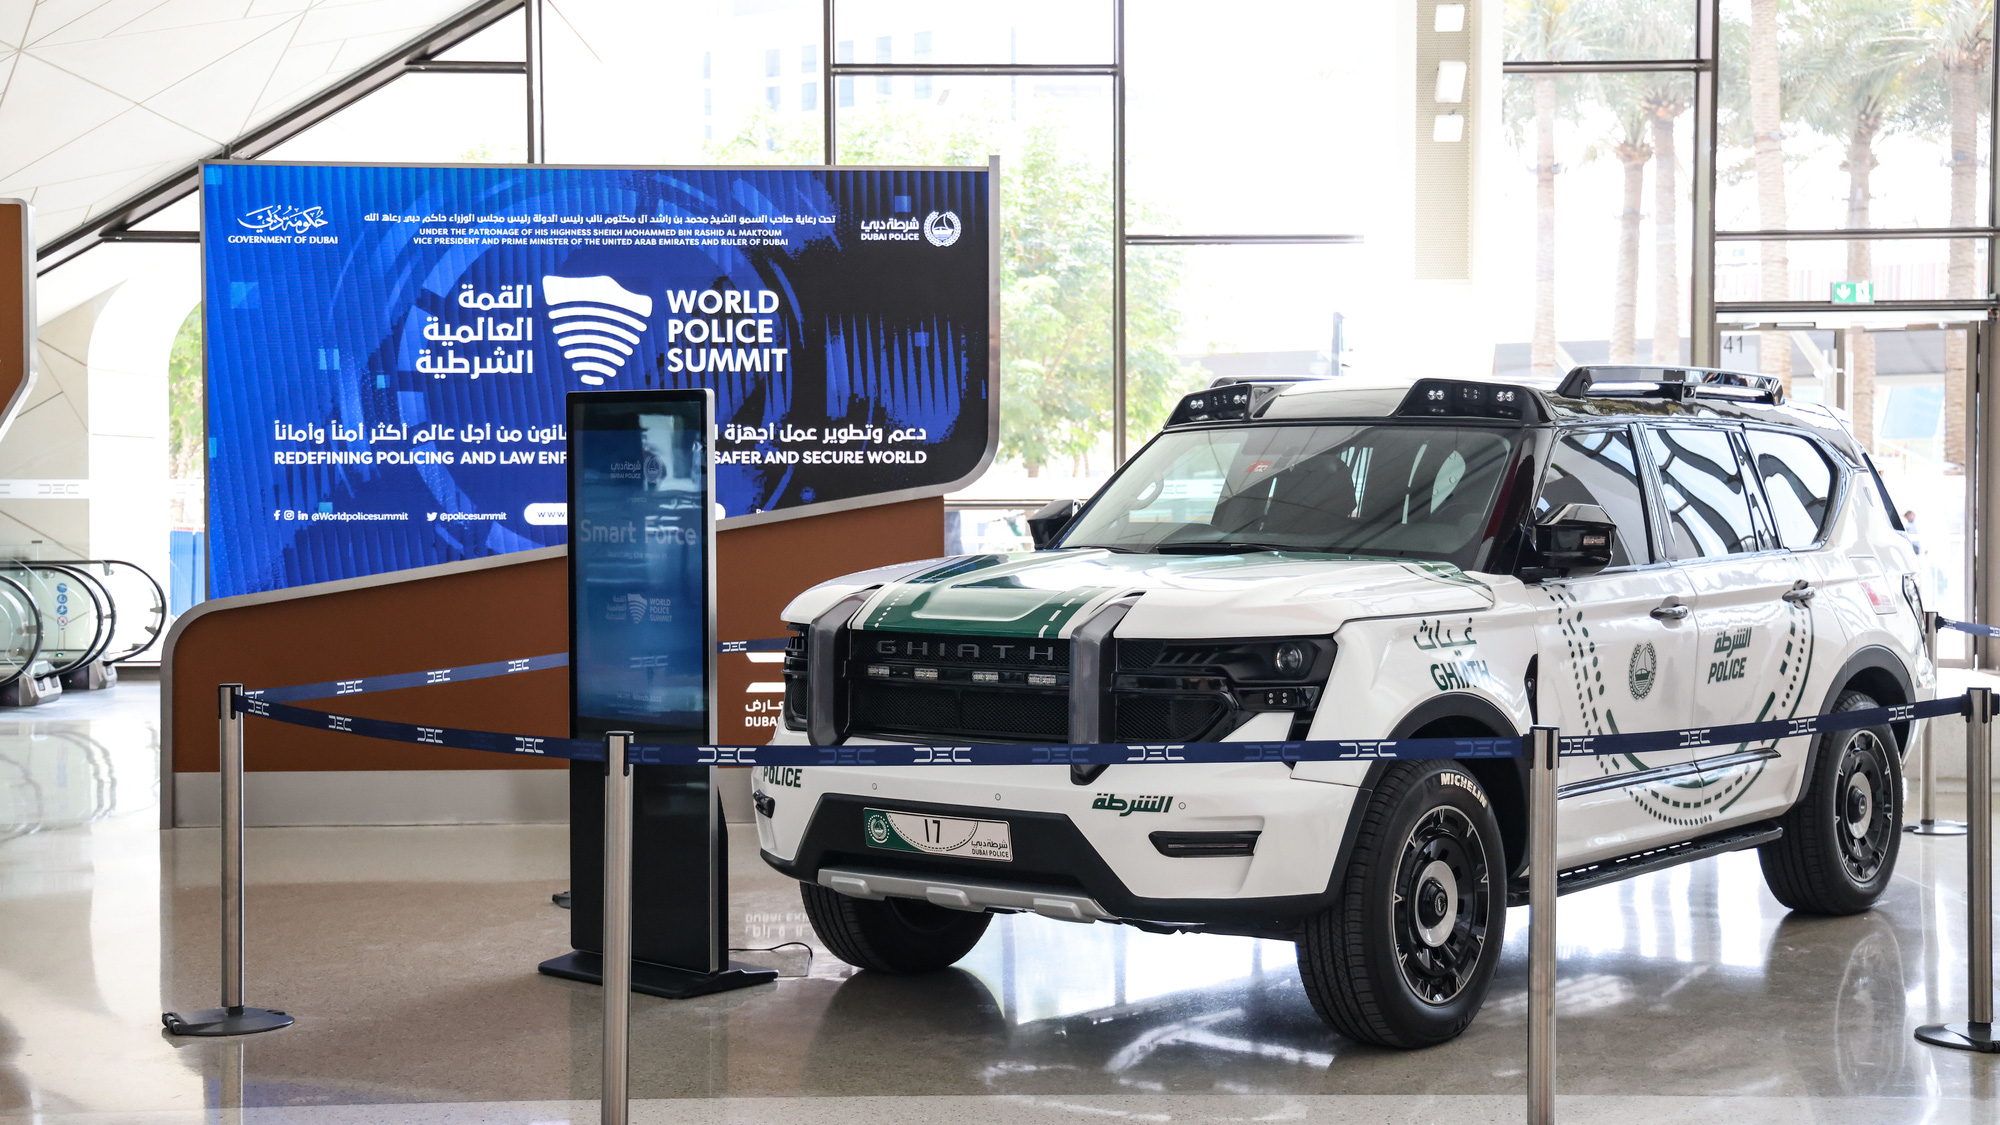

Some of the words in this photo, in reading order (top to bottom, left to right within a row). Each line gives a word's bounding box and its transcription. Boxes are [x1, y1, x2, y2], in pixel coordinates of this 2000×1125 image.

[365, 213, 379, 221] الله
[422, 214, 446, 223] حاكم
[449, 214, 474, 223] الوزراء
[477, 214, 505, 223] مجلس
[508, 214, 530, 224] رئيس
[533, 214, 557, 224] الدولة
[560, 215, 583, 224] رئيس
[586, 215, 602, 224] نائب
[605, 215, 636, 224] مكتوم
[650, 214, 671, 224] راشد
[674, 216, 682, 224] بن
[710, 214, 736, 224] الشيخ
[739, 215, 767, 224] السمو
[770, 215, 793, 224] صاحب
[796, 215, 816, 225] رعاية
[861, 220, 886, 232] دبي
[887, 217, 919, 232] شرطة
[228, 236, 292, 244] GOVERNMENT
[294, 236, 307, 244] OF
[309, 236, 338, 244] DUBAI
[458, 284, 532, 311] القمة
[666, 290, 779, 314] WORLD
[423, 316, 533, 347] العالمية
[668, 319, 773, 343] POLICE
[1724, 336, 1742, 353] 41
[416, 346, 533, 380] الشرطية
[667, 348, 788, 372] SUMMIT
[369, 422, 407, 444] أكثر
[413, 424, 455, 444] عالم
[460, 423, 491, 444] أجل
[497, 426, 522, 442] من
[724, 423, 774, 444] أجهزة
[780, 424, 817, 441] عمل
[822, 424, 883, 444] وتطوير
[888, 426, 927, 444] دعم
[274, 452, 373, 464] REDEFINING
[376, 452, 454, 464] POLICING
[460, 452, 496, 464] AND
[500, 452, 536, 464] LAW
[714, 451, 762, 464] SAFER
[764, 451, 799, 464] AND
[802, 451, 864, 464] SECURE
[867, 451, 927, 464] WORLD
[311, 512, 408, 522] @Worldpolicesummit
[440, 512, 507, 522] @policesummit
[580, 520, 637, 543] Smart
[644, 520, 697, 546] Force
[650, 598, 671, 606] WORLD
[650, 606, 670, 614] POLICE
[650, 614, 672, 622] SUMMIT
[1413, 617, 1477, 656] غياث
[1714, 627, 1752, 658] الشرطة
[876, 640, 1054, 660] GHIATH
[1430, 660, 1493, 690] GHIATH
[1707, 658, 1747, 684] POLICE
[763, 766, 802, 788] POLICE
[1440, 772, 1488, 808] MICHELIN
[1092, 793, 1174, 816] الشرطة
[971, 840, 986, 848] دبي
[987, 839, 1008, 849] شرطة
[972, 848, 988, 856] DUBAI
[989, 850, 1008, 858] POLICE
